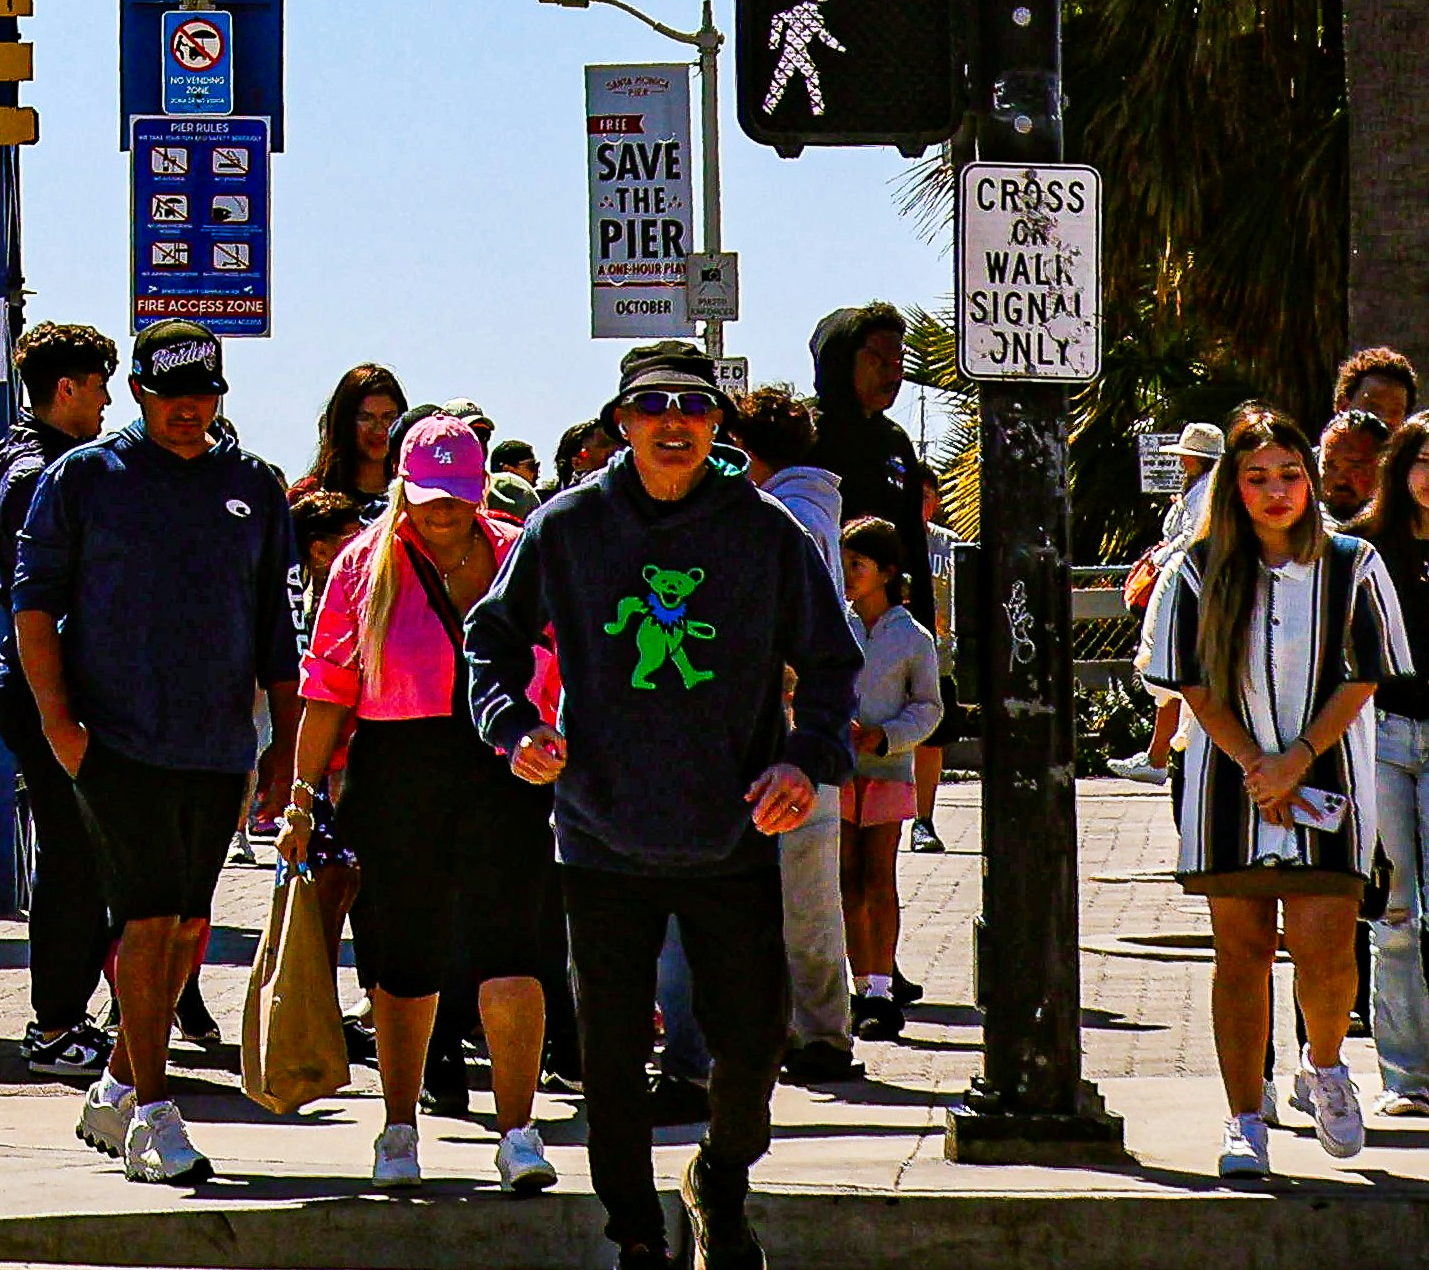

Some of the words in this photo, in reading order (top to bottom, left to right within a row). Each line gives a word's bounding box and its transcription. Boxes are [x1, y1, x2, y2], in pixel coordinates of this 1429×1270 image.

[170, 123, 194, 132] PIER
[196, 123, 230, 132] RULES
[599, 118, 628, 131] FREE
[597, 140, 682, 181] SAVE
[615, 186, 667, 214] THE
[977, 178, 1086, 214] CROSS
[598, 218, 686, 259] PIER
[598, 263, 606, 276] A
[984, 251, 1075, 287] WALK
[137, 299, 165, 312] FIRE
[168, 299, 223, 313] ACCESS
[226, 300, 263, 312] ZONE
[616, 299, 673, 316] OCTOBER
[712, 365, 743, 380] ED
